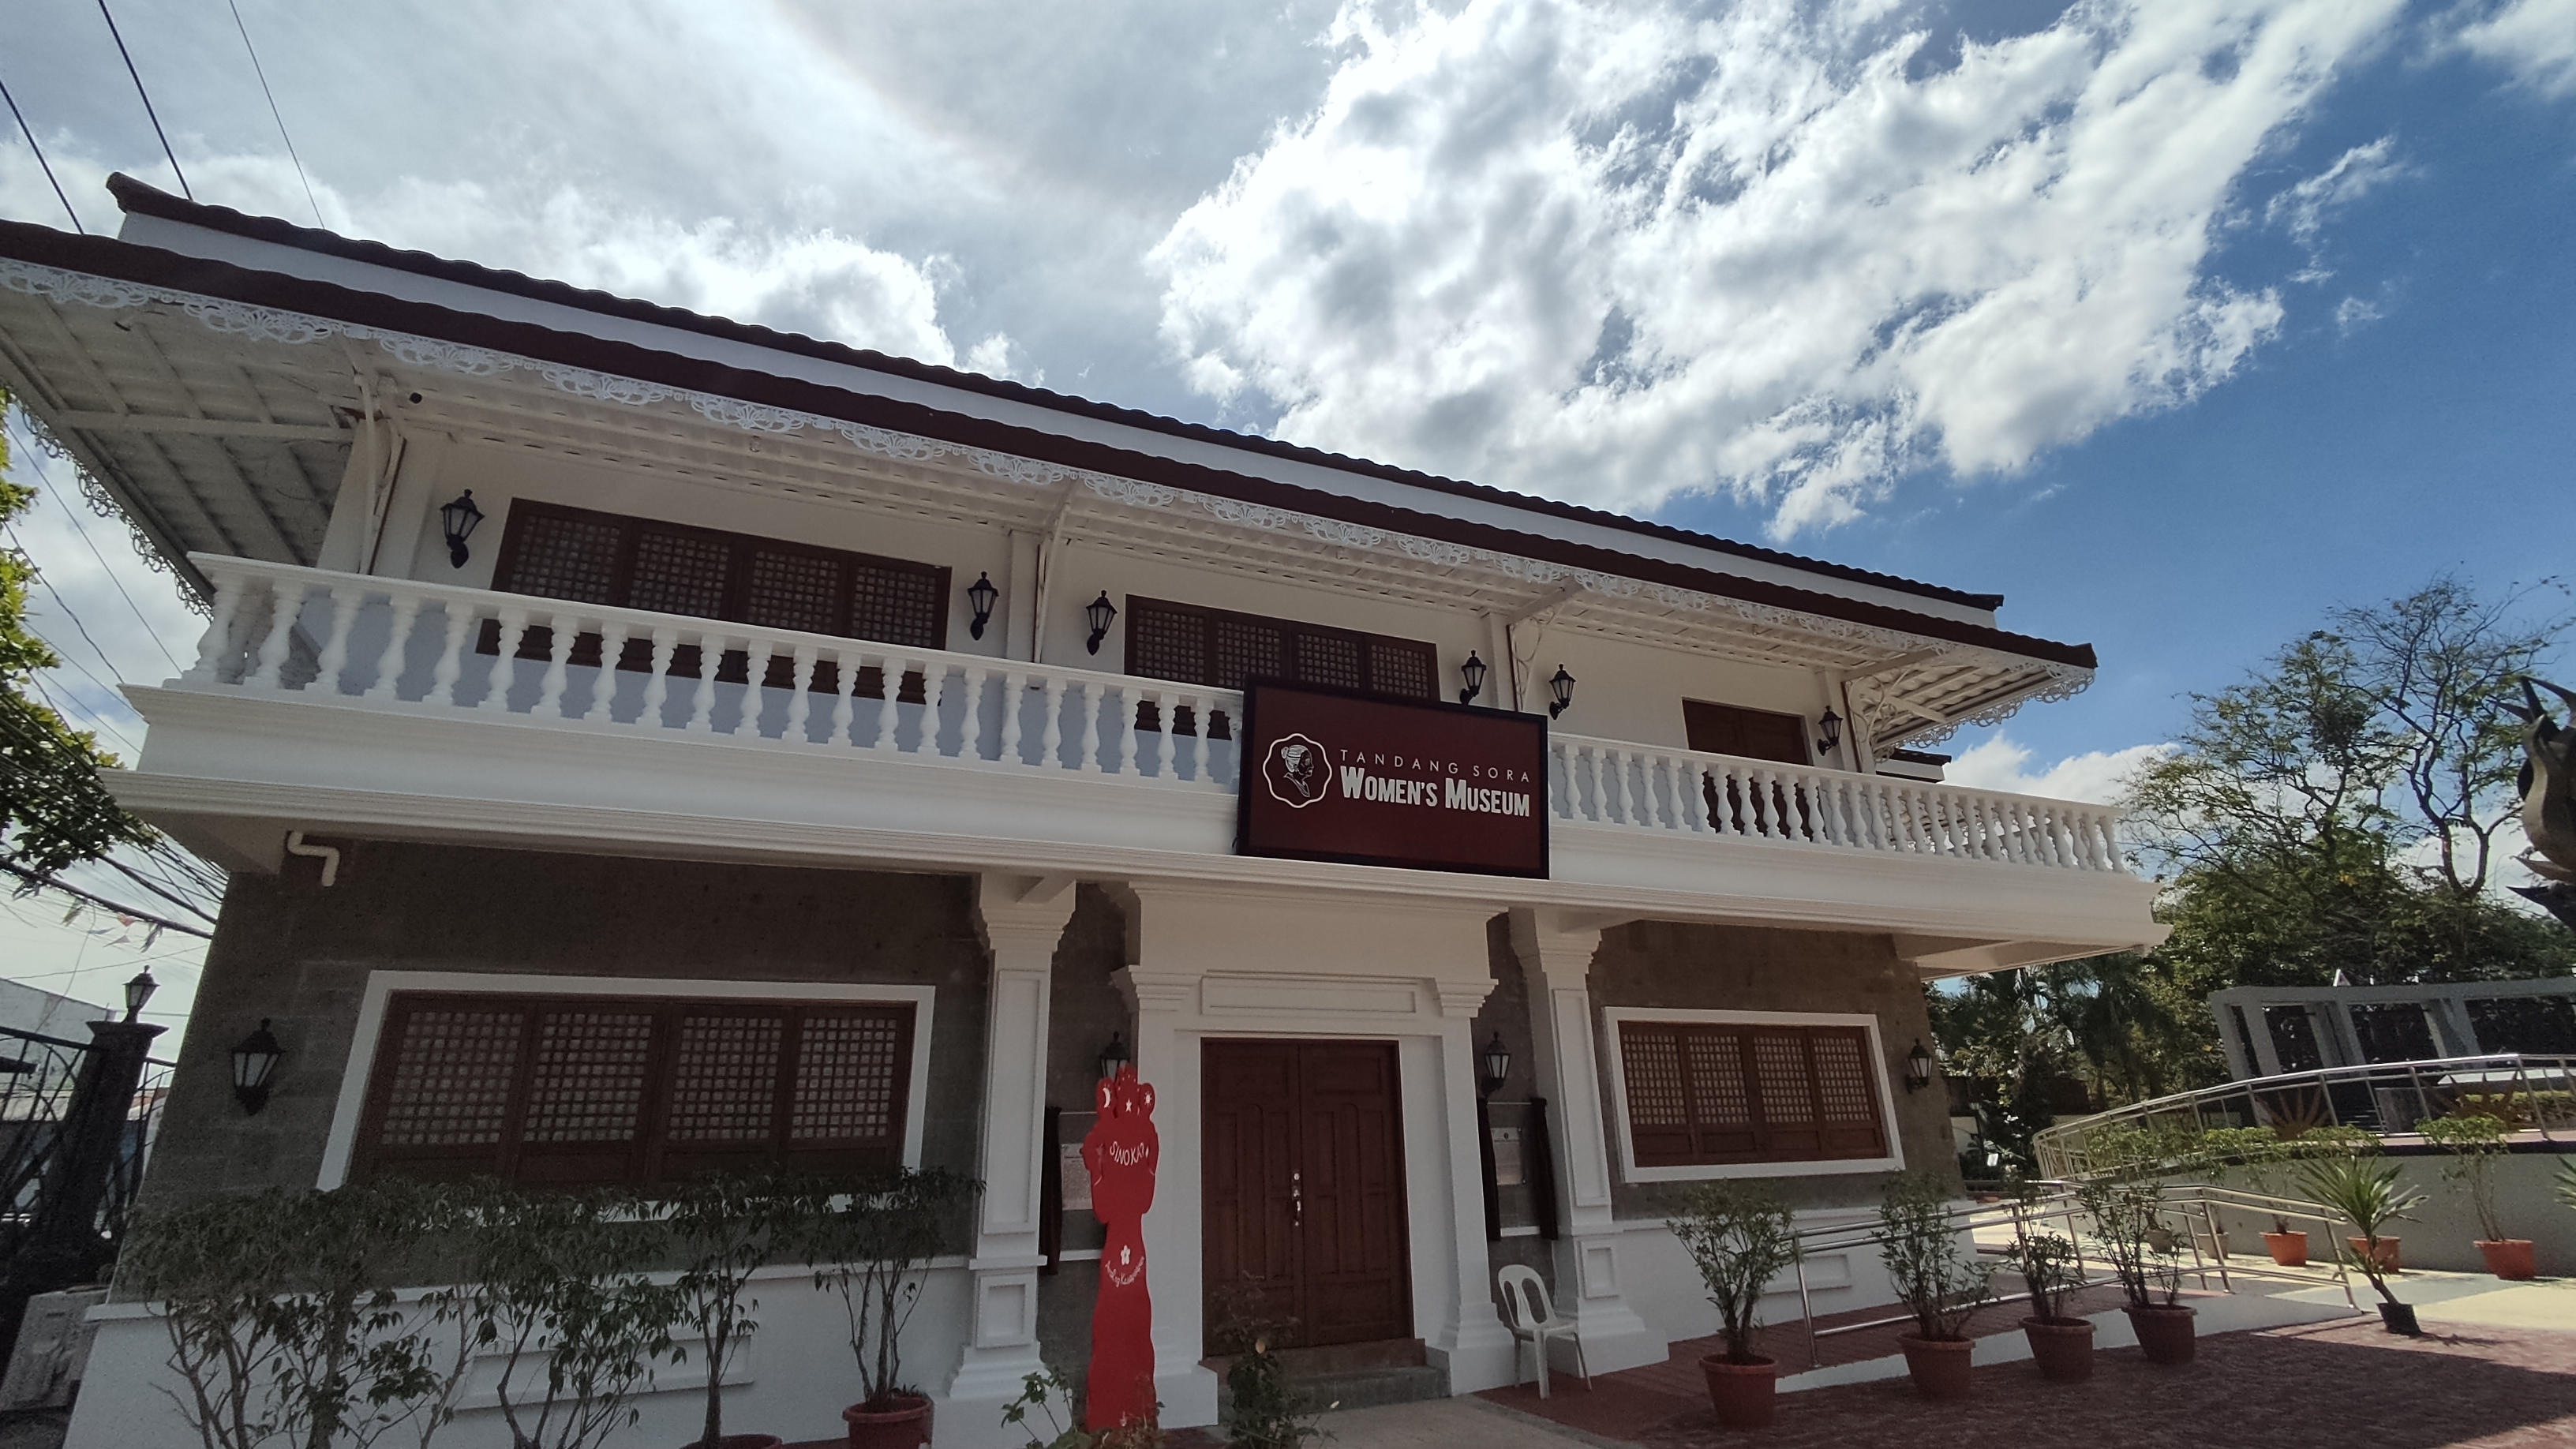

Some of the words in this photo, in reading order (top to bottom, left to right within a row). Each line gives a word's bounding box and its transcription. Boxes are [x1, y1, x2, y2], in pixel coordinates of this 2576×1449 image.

[1340, 749, 1458, 774] TANDANG
[1473, 765, 1530, 783] SORA
[1340, 766, 1438, 807] WOMEN'S
[1445, 777, 1530, 817] MUSEUM
